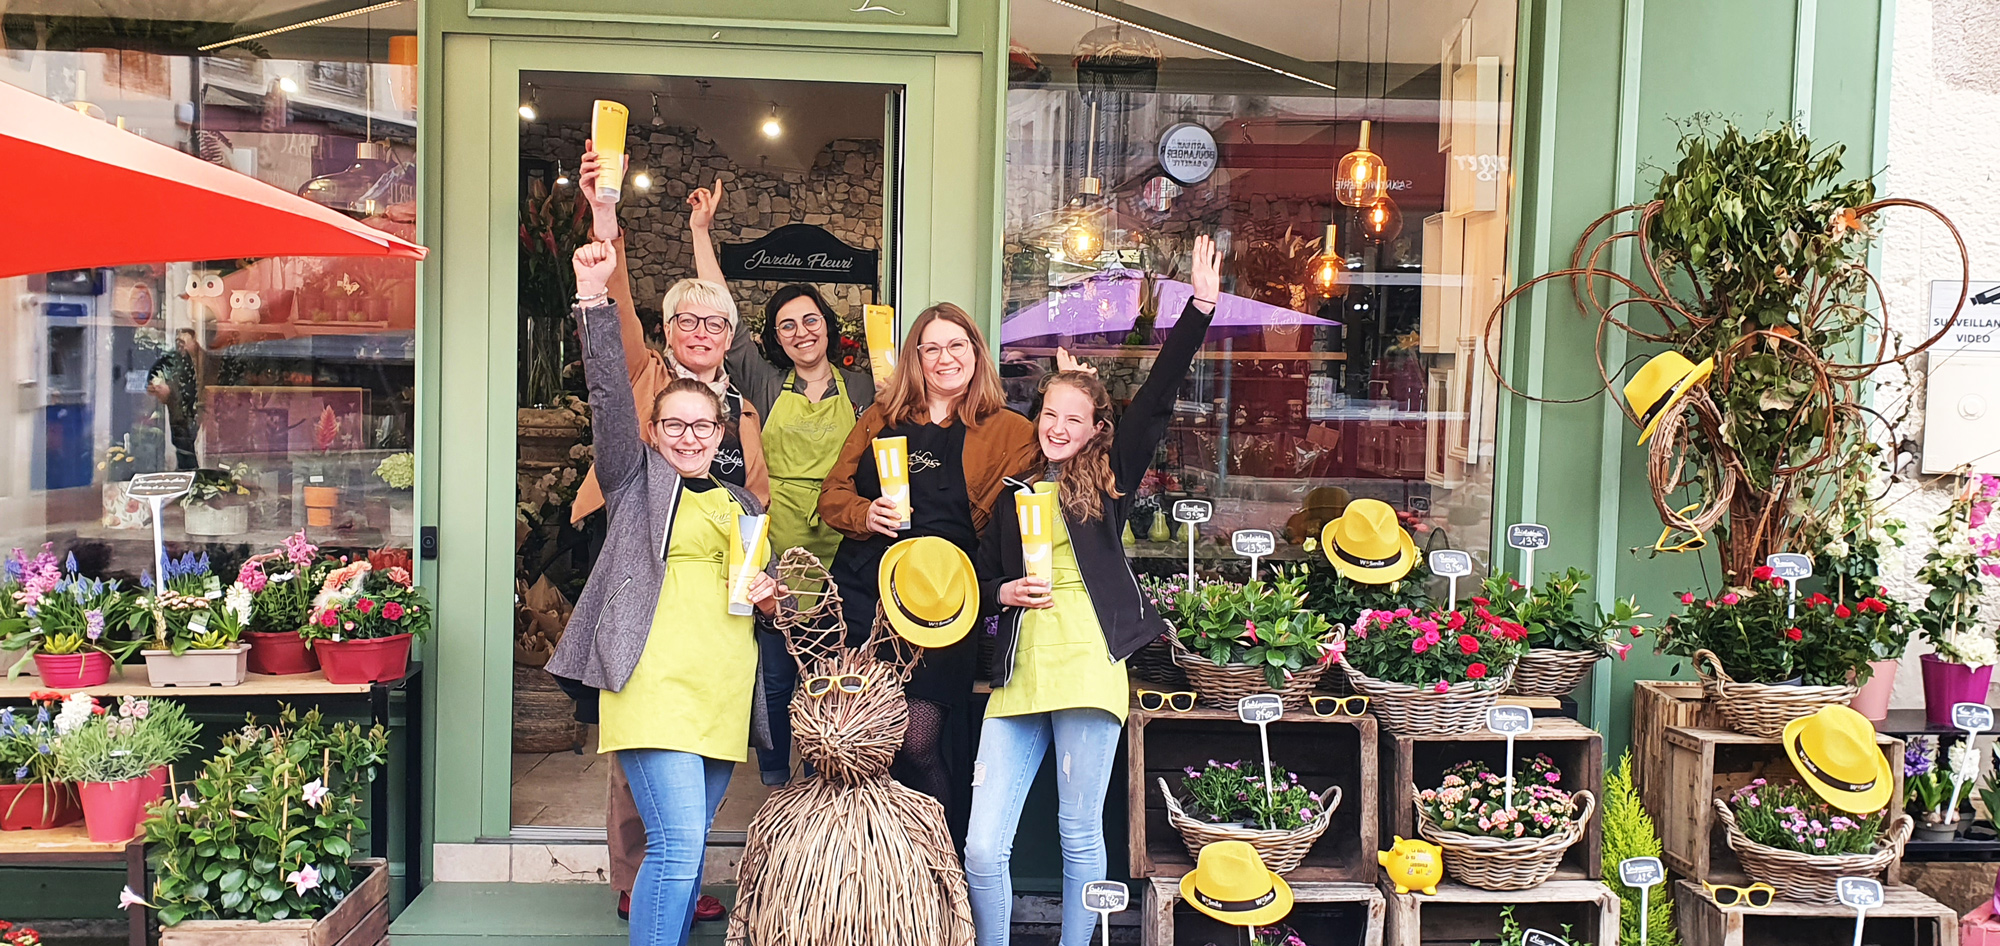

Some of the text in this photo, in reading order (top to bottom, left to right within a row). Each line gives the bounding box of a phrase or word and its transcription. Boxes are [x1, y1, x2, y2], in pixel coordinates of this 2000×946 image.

[744, 249, 853, 270] Jardin Fleuri
[1934, 317, 2000, 328] SUVEILLAN
[1956, 334, 1991, 343] VIDEO
